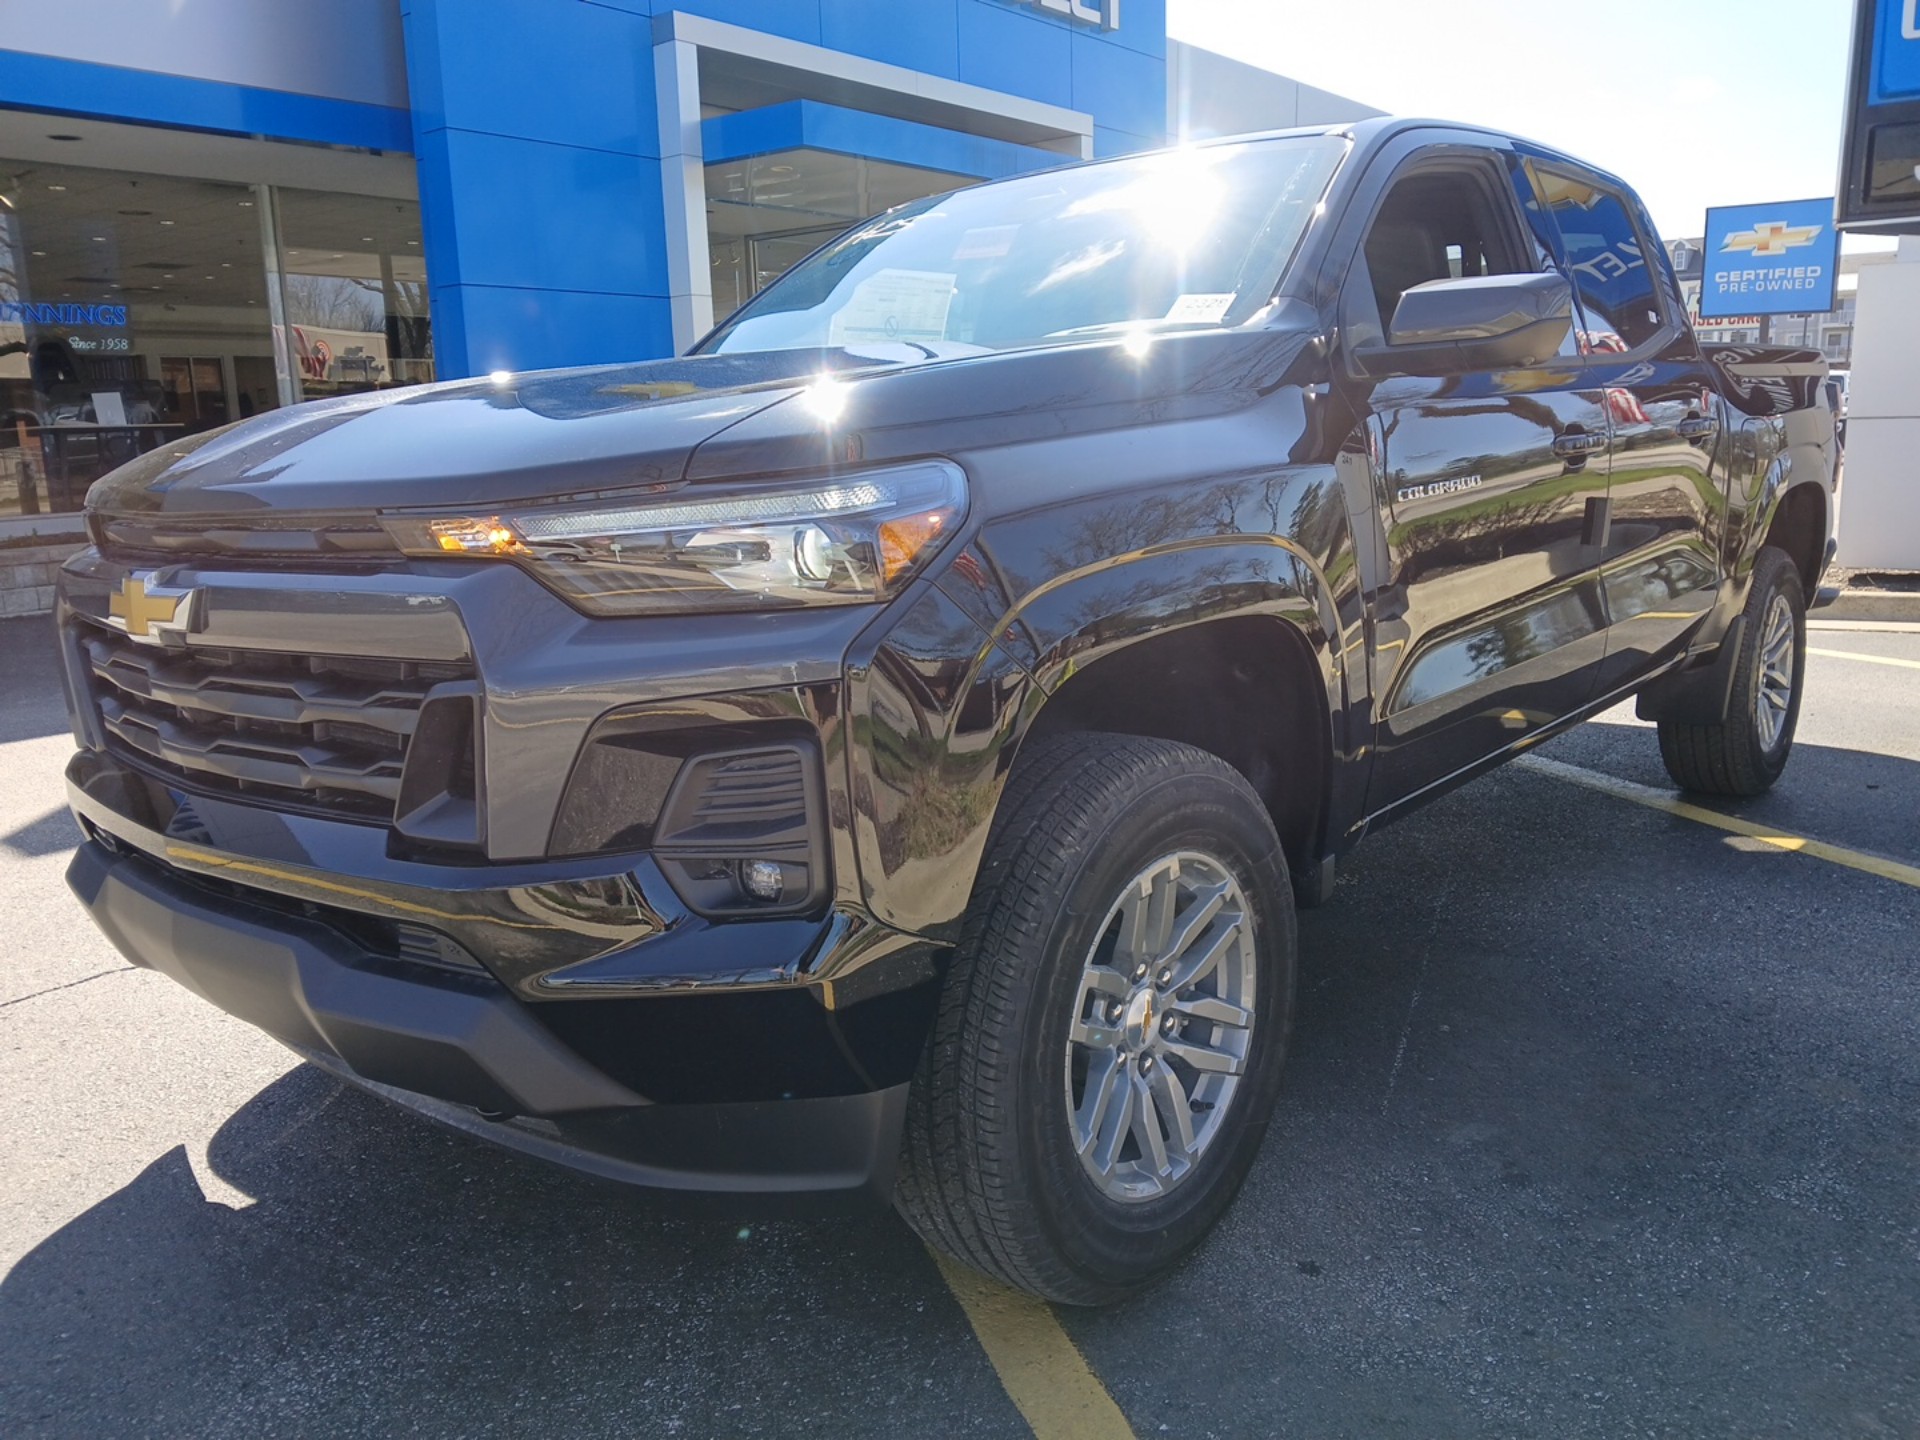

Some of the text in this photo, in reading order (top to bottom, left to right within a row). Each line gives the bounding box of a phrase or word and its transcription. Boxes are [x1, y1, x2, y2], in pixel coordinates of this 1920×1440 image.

[1714, 265, 1822, 284] CERTIFIED
[1718, 278, 1816, 294] PRE-OWNED
[68, 335, 129, 350] Since 1958
[1398, 474, 1482, 502] COLORADO
